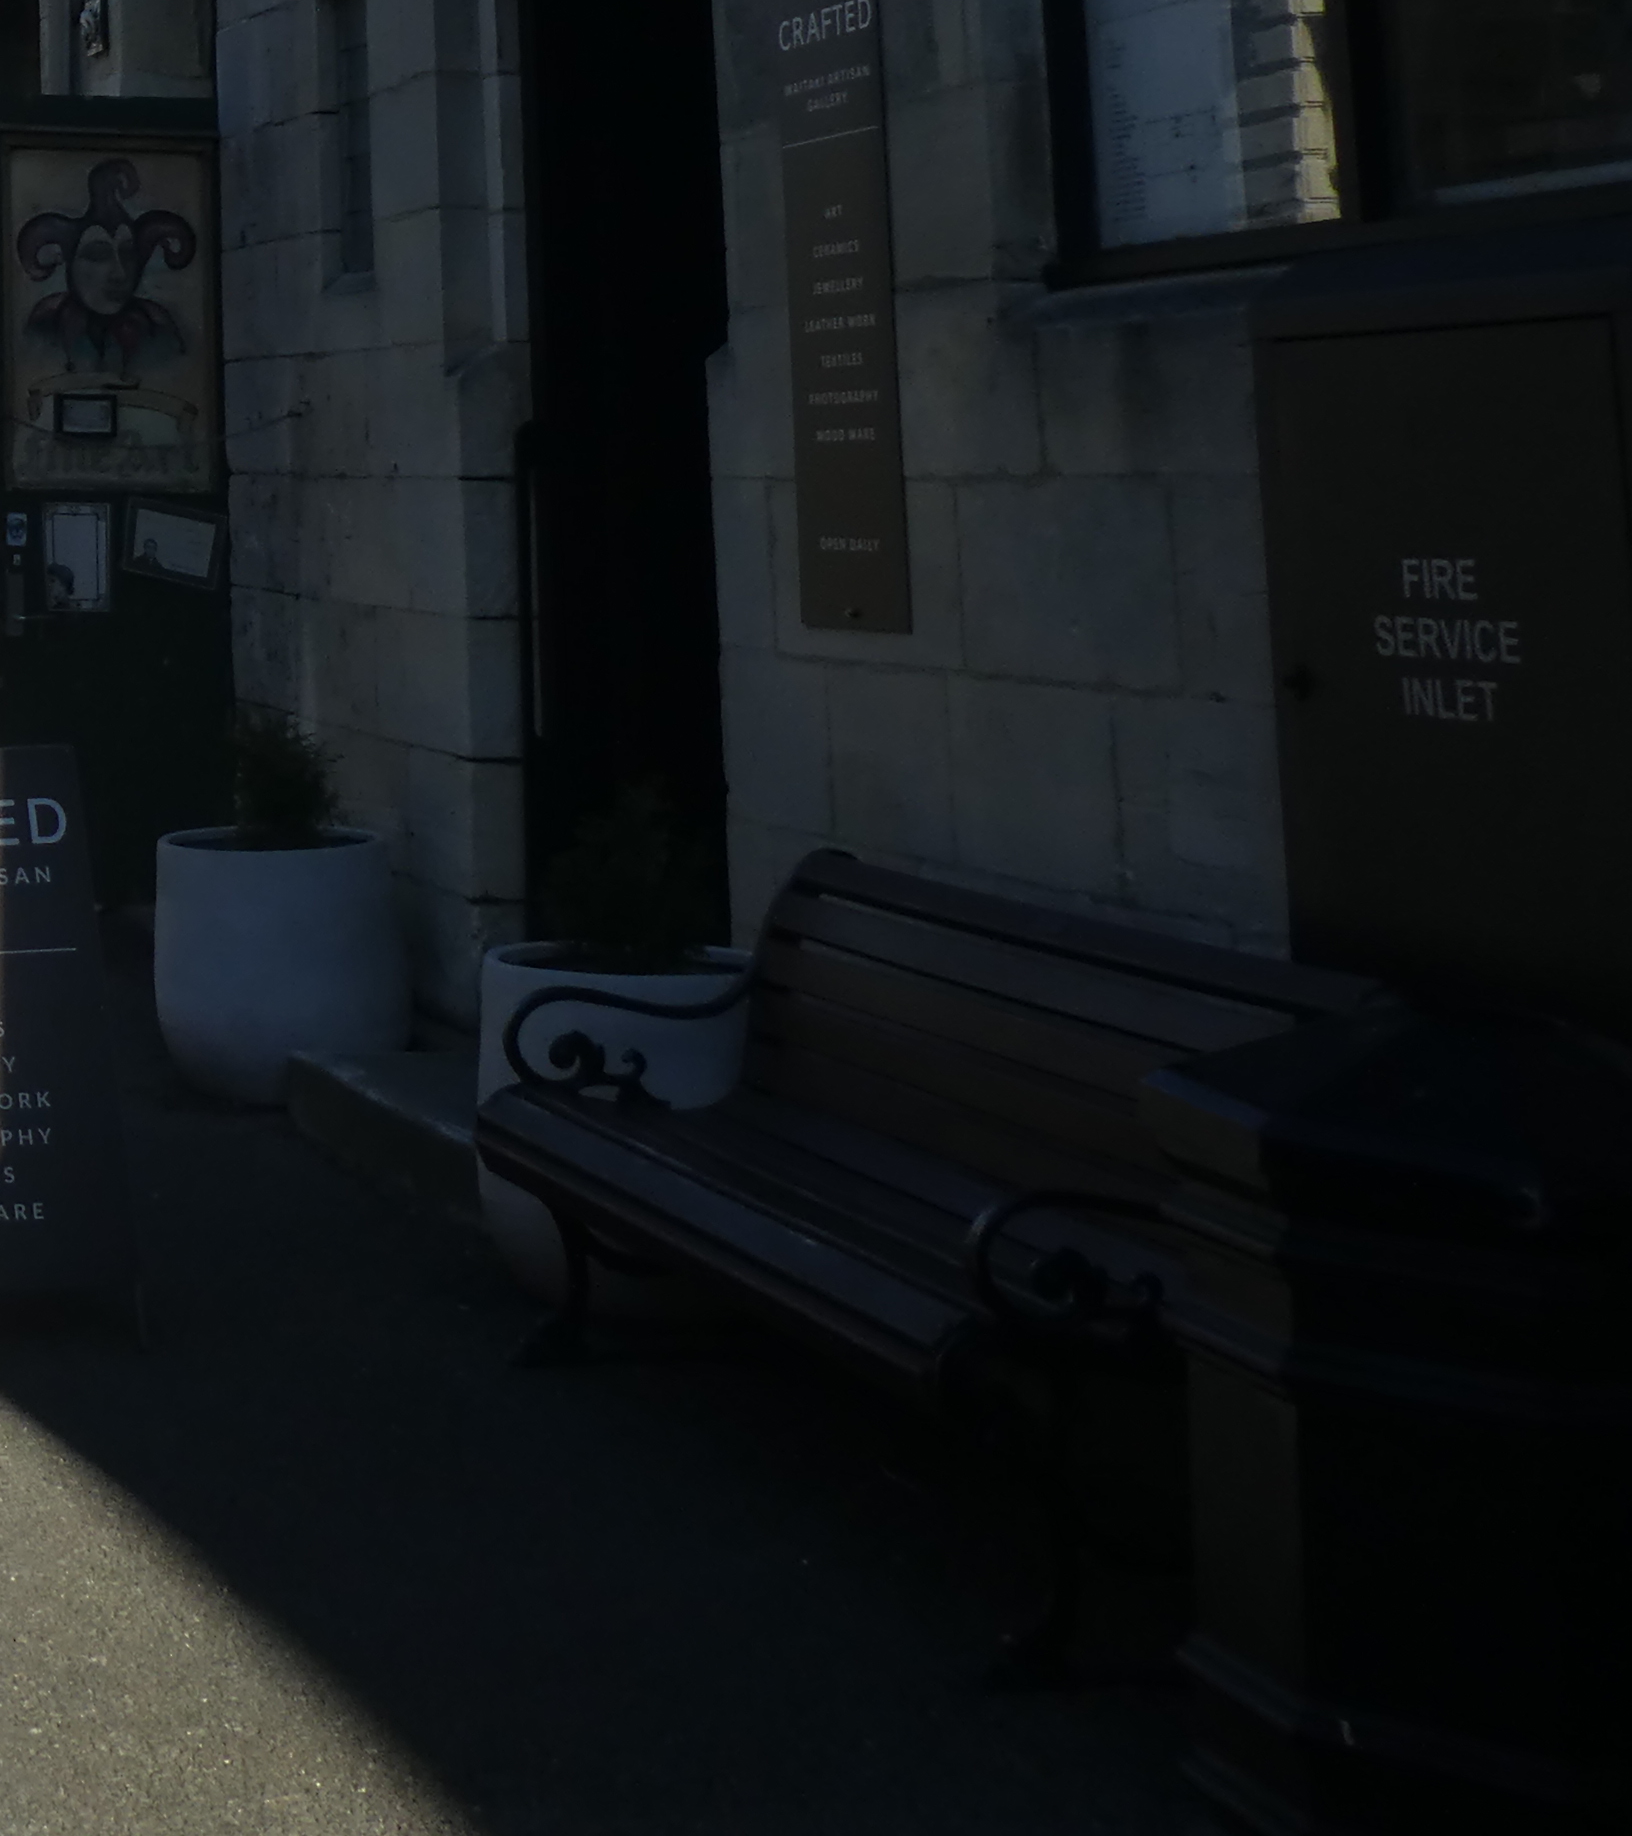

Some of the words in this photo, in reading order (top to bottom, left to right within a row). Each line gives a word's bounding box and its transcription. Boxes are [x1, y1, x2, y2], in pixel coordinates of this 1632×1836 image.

[819, 536, 846, 551] OPEN
[1401, 558, 1479, 601] FIRE
[1373, 615, 1522, 664] SERVICE
[1402, 677, 1499, 722] INLET
